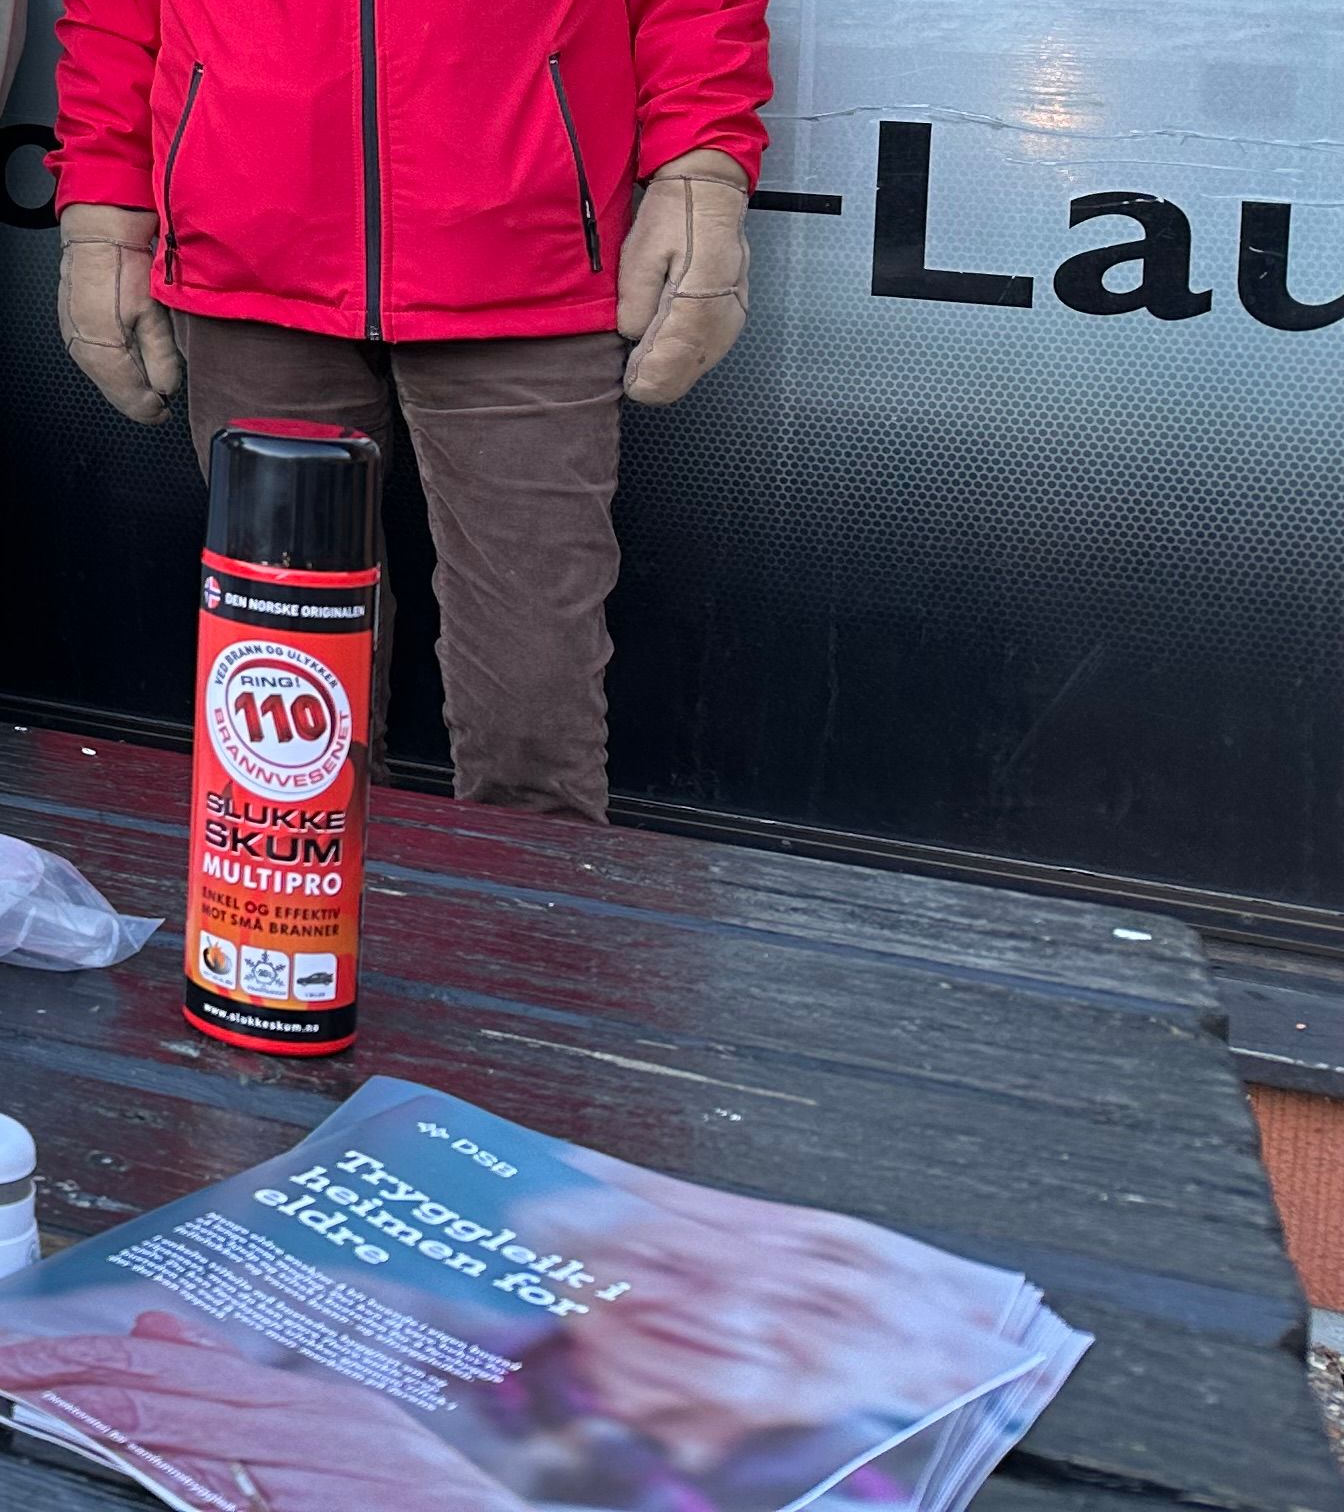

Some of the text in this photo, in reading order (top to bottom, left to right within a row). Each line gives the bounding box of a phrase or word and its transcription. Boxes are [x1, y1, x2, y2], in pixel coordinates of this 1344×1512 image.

[224, 592, 366, 619] DEN NORSKE ORIGINALEN
[214, 645, 338, 689] VED BRANN OG ULYKKER
[240, 675, 301, 689] RING!
[234, 691, 327, 744] 110
[214, 707, 351, 788] BRANNVESENET
[206, 791, 347, 833] SLUKKE
[205, 819, 343, 868] SKUM
[202, 851, 343, 897] MULTIPRO
[201, 903, 341, 937] MOT SMÅ BRANNER
[202, 886, 341, 921] ENKEL OG EFFEKTIV
[203, 1002, 320, 1033] www.slukkeskum.no
[449, 1135, 519, 1179] DSB
[253, 1185, 391, 1267] eldre
[289, 1167, 486, 1279] heimen
[492, 1268, 590, 1317] for
[335, 1149, 595, 1290] Tryggleik
[593, 1280, 632, 1304] i
